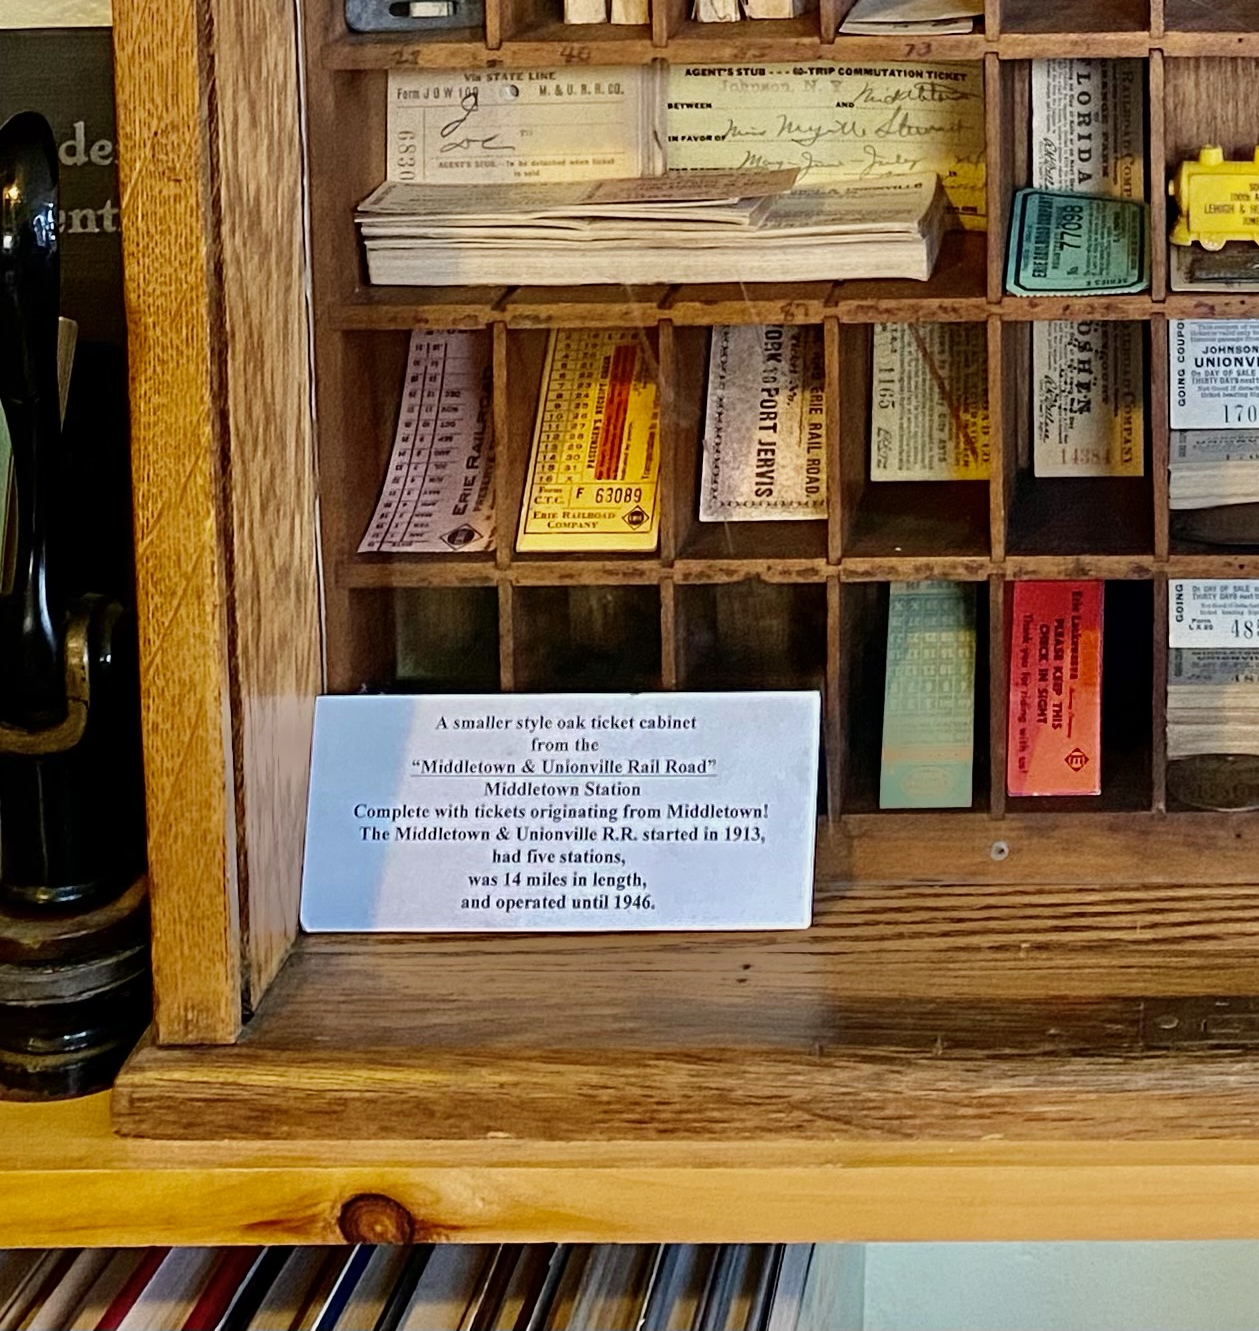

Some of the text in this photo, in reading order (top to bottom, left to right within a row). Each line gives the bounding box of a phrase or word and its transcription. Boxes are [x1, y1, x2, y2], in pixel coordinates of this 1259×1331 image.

[486, 71, 556, 81] STATE LINE
[685, 67, 968, 82] AGENT'S STUB COMMUTATION TICKET
[397, 83, 624, 100] Form J W M. & CO.
[667, 102, 712, 110] BETWEEN
[1204, 204, 1235, 214] LEHIGH
[1060, 205, 1084, 250] 77098
[878, 366, 896, 410] 1165
[807, 387, 823, 454] ERIE RAIL
[755, 387, 779, 498] PORT JERVIS
[576, 487, 642, 503] F 63089
[533, 511, 616, 520] ERIE RAILROAD
[547, 521, 599, 529] COMPANY
[1175, 584, 1184, 623] GOING
[1019, 613, 1033, 668] Thank you
[1036, 624, 1048, 724] CHECK IN SIGHT
[1052, 618, 1064, 730] PLEASE KEEP THIS
[436, 715, 697, 732] A smaller style oak ticket cabinet
[531, 739, 599, 752] from the
[412, 759, 717, 774] “Middletown & Unionville Rail Road”
[484, 782, 641, 796] Middletown Station
[353, 804, 770, 822] Complete with tickets originating from Middletown!
[360, 826, 767, 844] The Middletown & Unionville R.R. started in 1913,
[492, 849, 626, 866] had five stations,
[468, 872, 647, 891] was 14 miles in length,
[461, 895, 655, 912] and operated until 1946.
